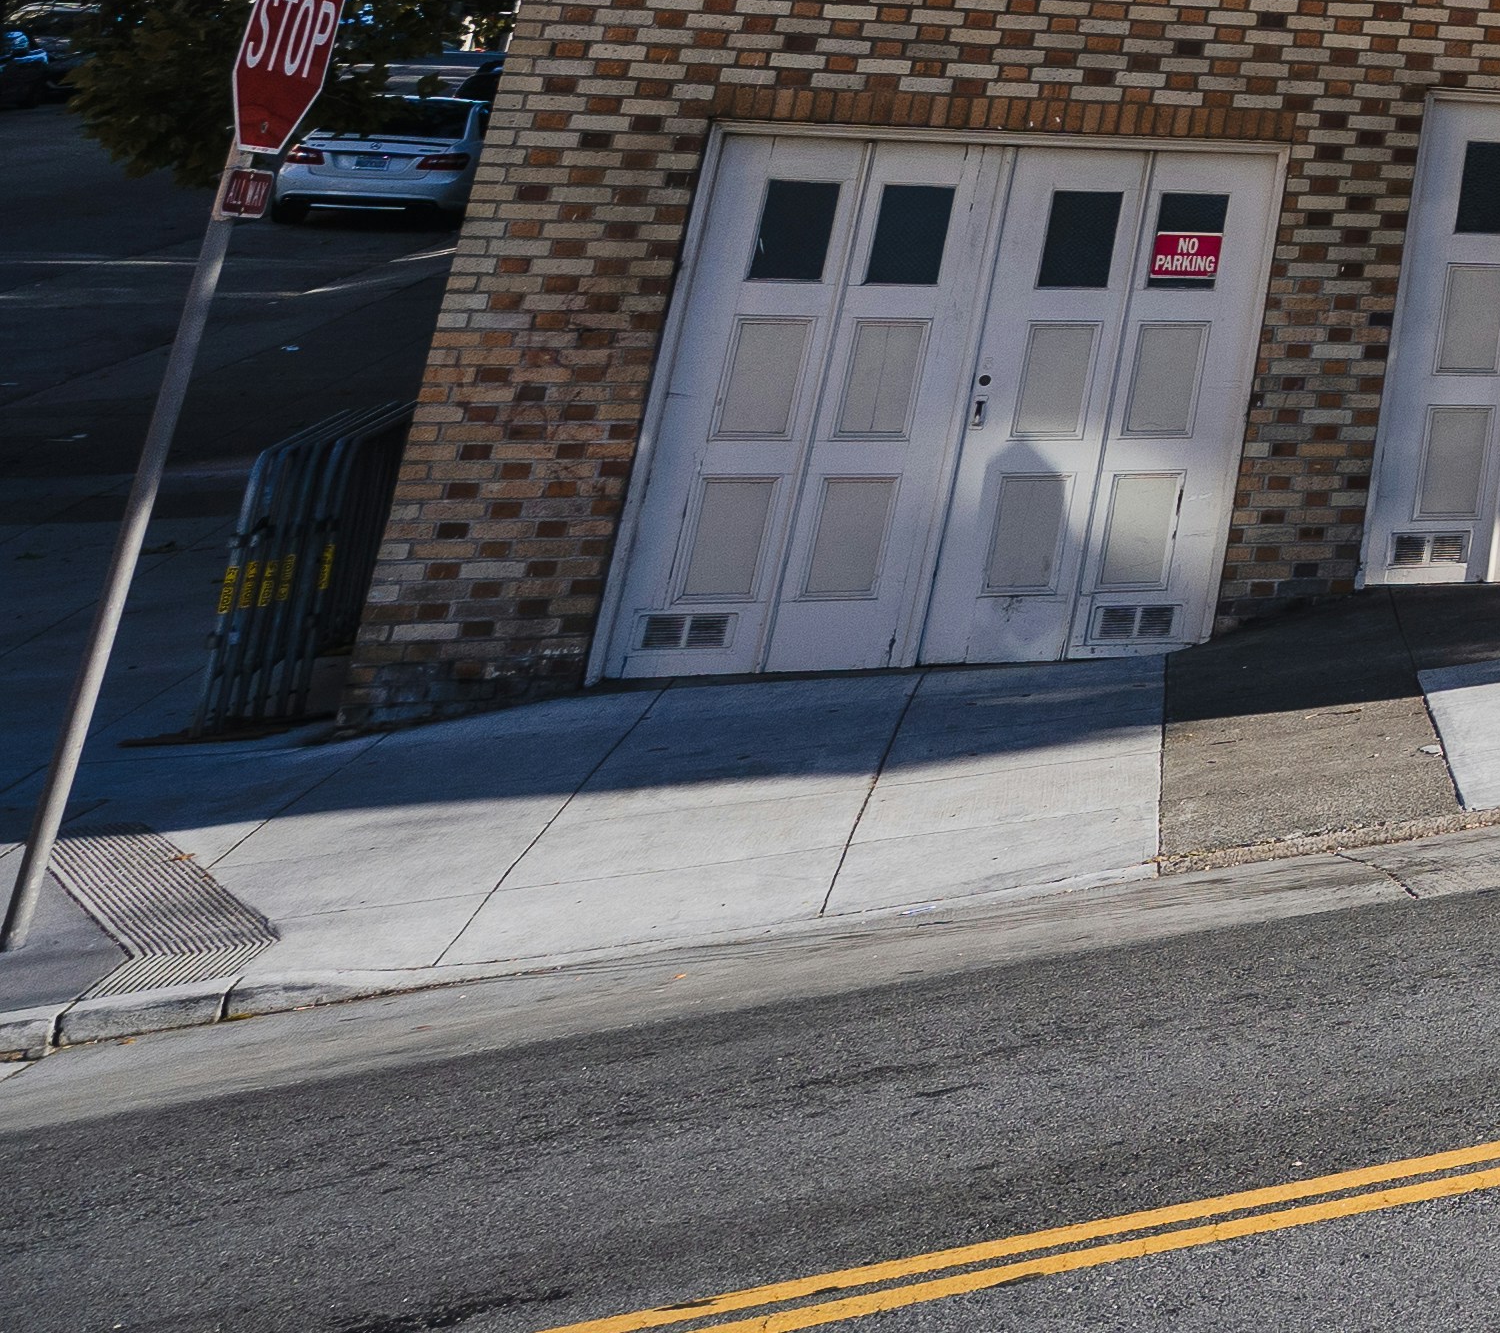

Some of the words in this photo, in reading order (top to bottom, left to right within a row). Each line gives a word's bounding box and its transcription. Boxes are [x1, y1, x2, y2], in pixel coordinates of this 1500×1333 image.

[226, 178, 246, 204] ALL
[245, 180, 268, 206] WAY
[1177, 237, 1199, 254] NO
[1154, 255, 1216, 272] PARKING
